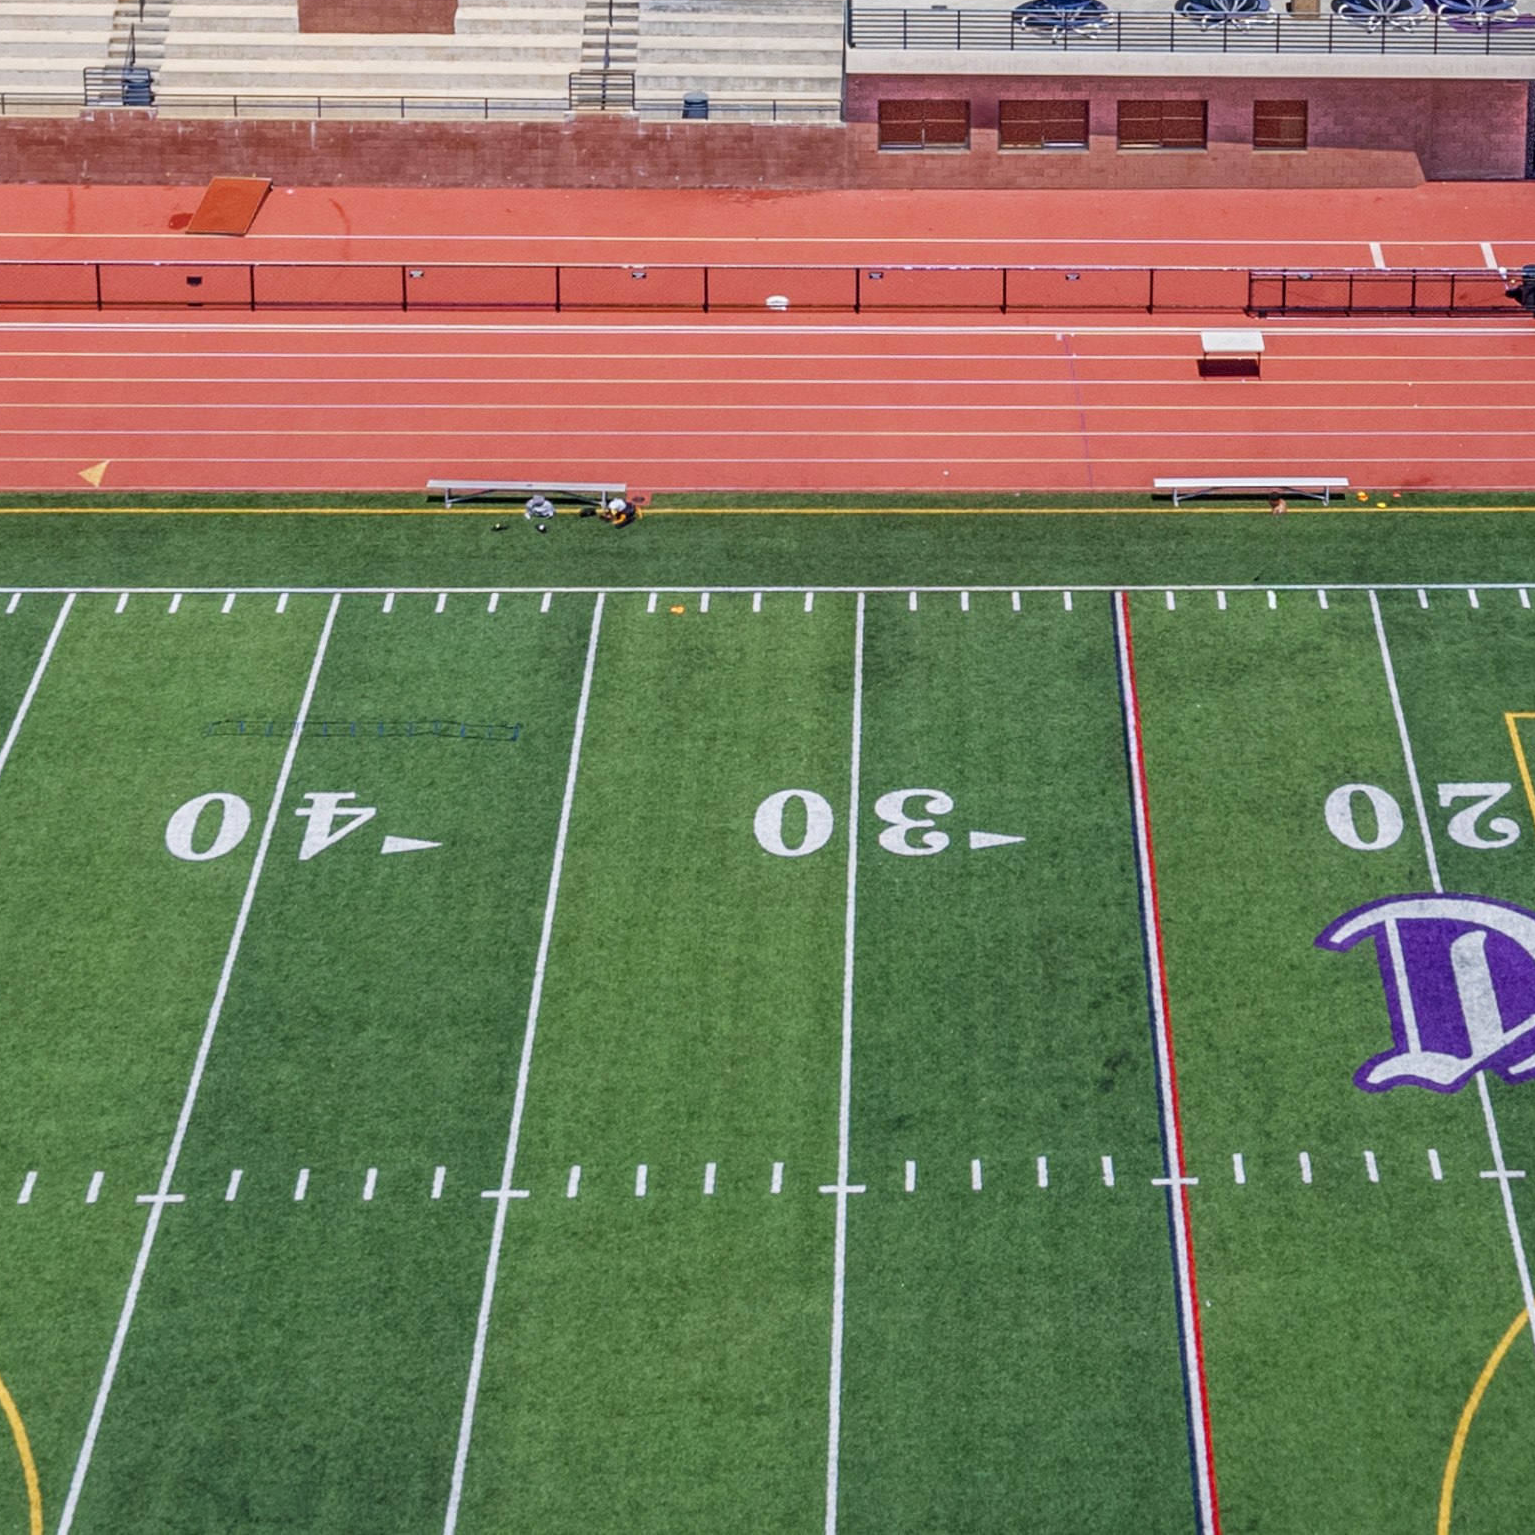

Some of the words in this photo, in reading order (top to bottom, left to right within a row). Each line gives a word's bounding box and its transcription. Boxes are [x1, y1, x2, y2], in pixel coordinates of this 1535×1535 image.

[164, 791, 377, 862] 40
[752, 787, 955, 858] 30
[1323, 781, 1521, 851] 20
